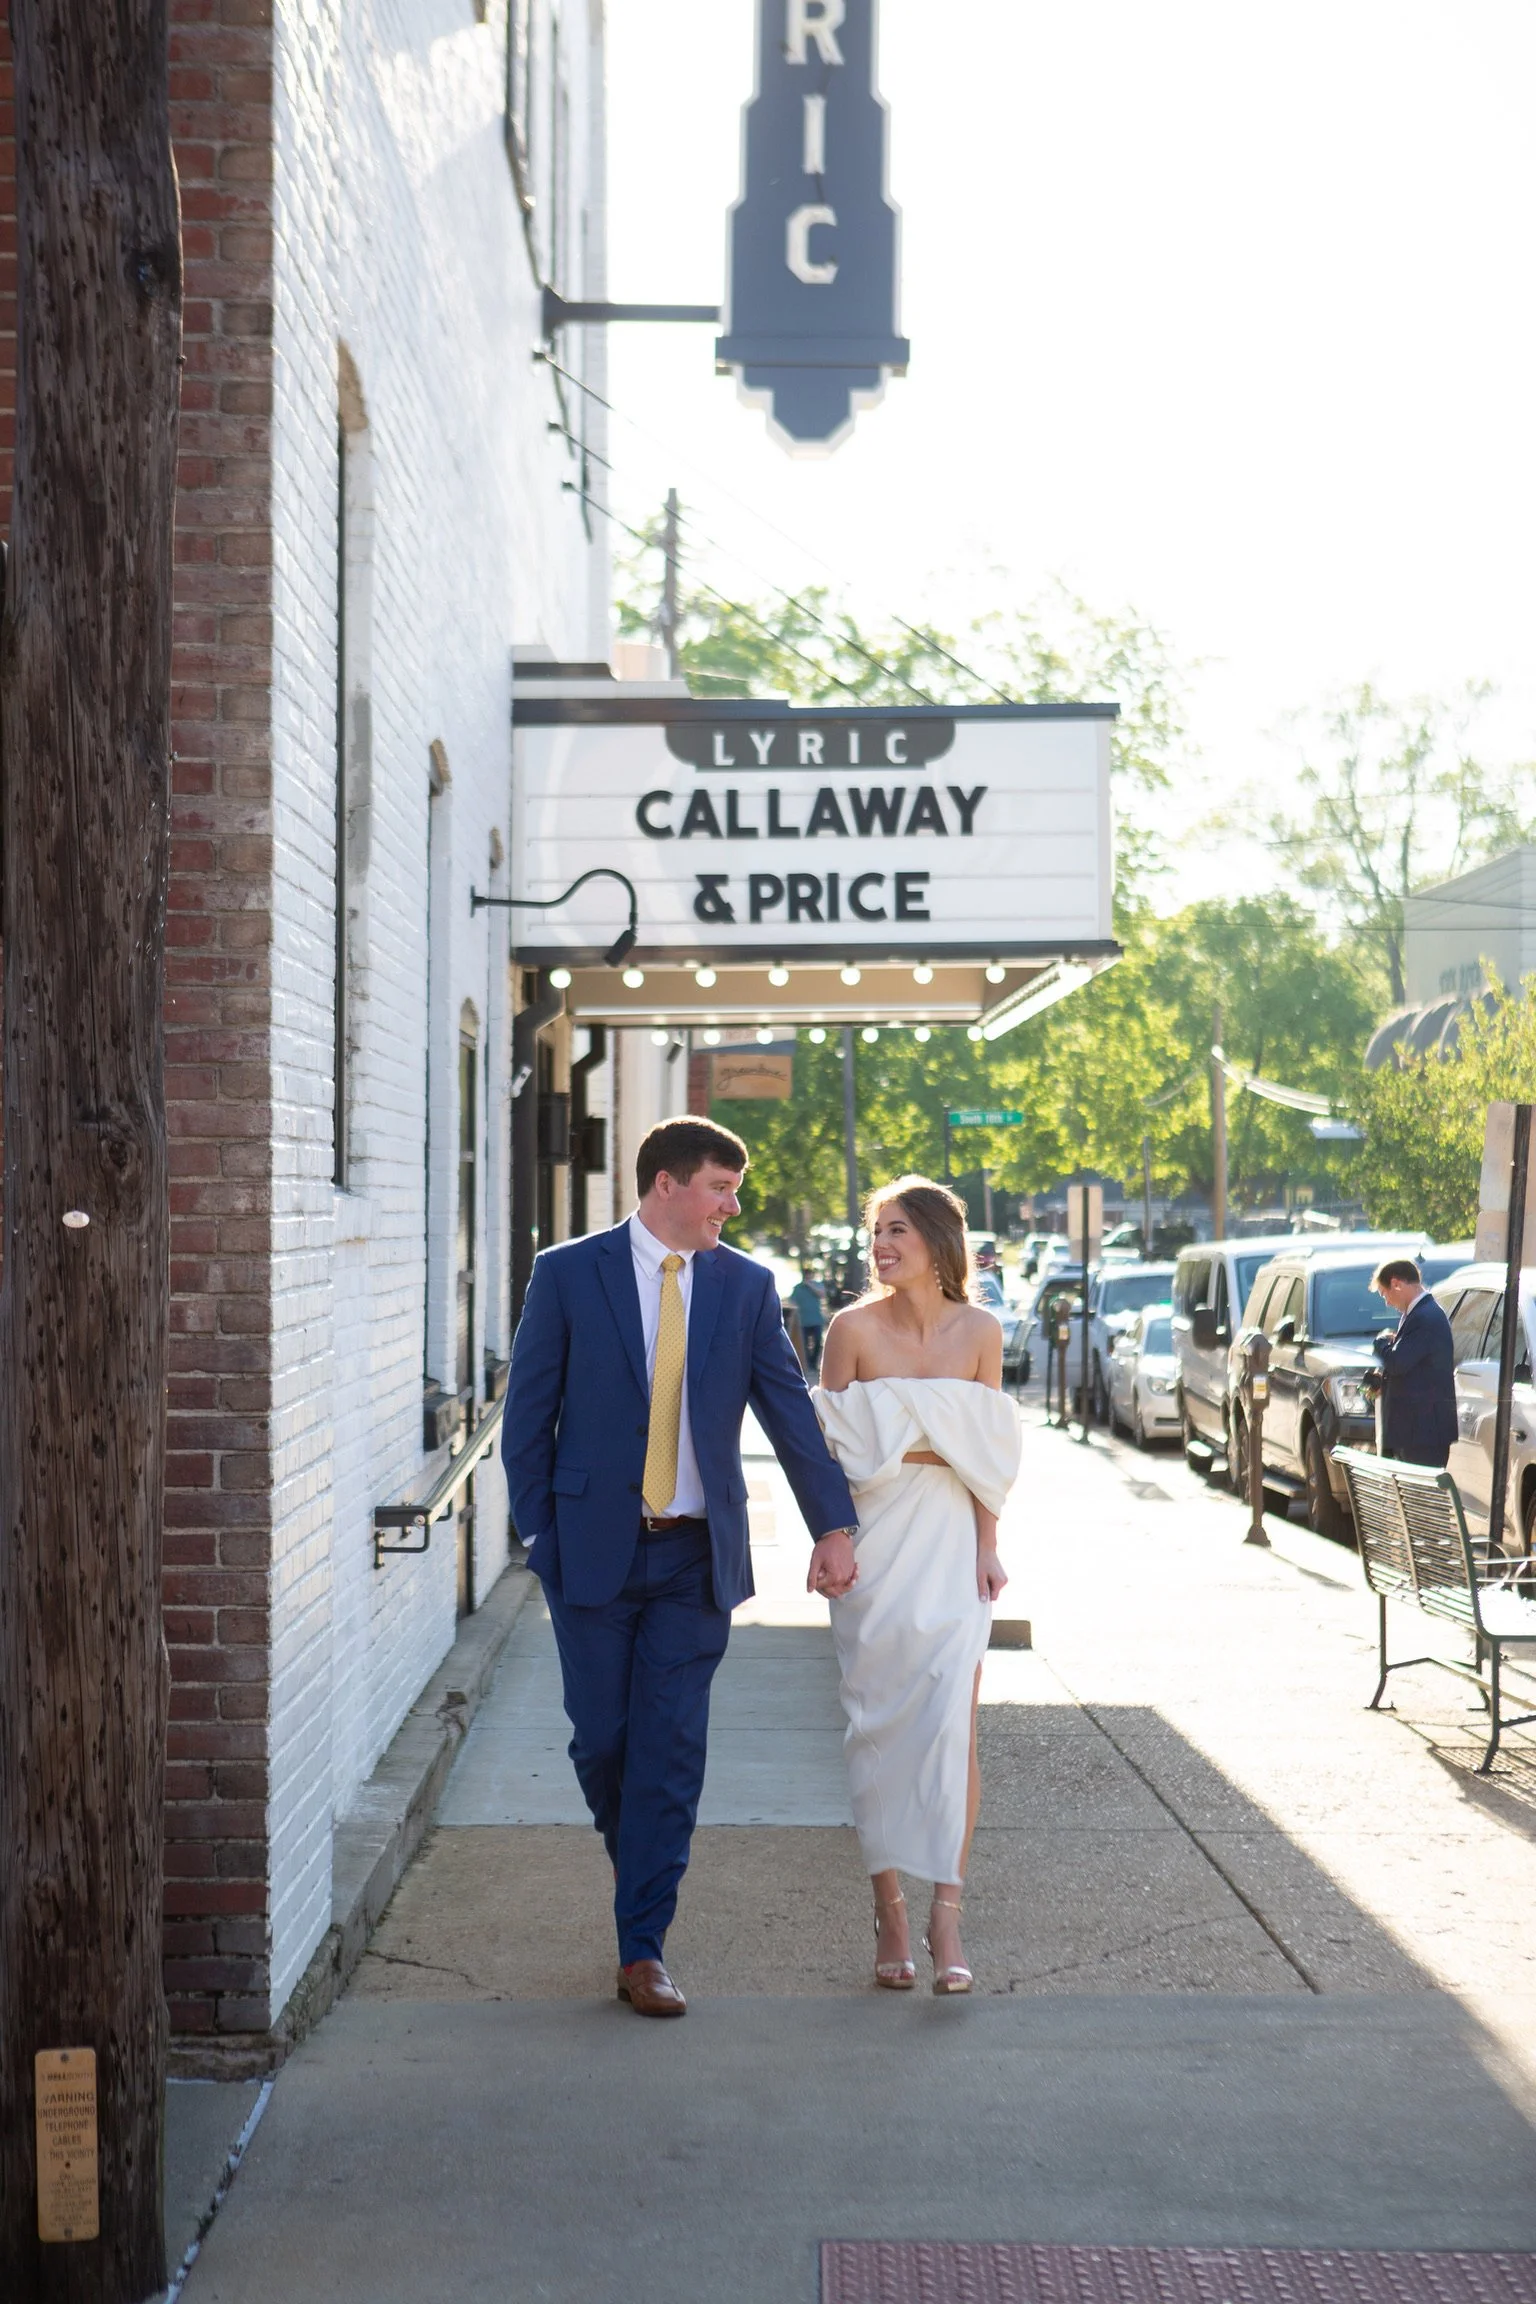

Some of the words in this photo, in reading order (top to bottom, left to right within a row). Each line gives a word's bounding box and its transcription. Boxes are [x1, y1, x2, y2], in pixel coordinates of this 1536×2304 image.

[713, 731, 909, 767] LYRIC
[635, 786, 989, 839] CALLAWAY
[693, 873, 735, 923] &
[750, 871, 931, 923] PRICE
